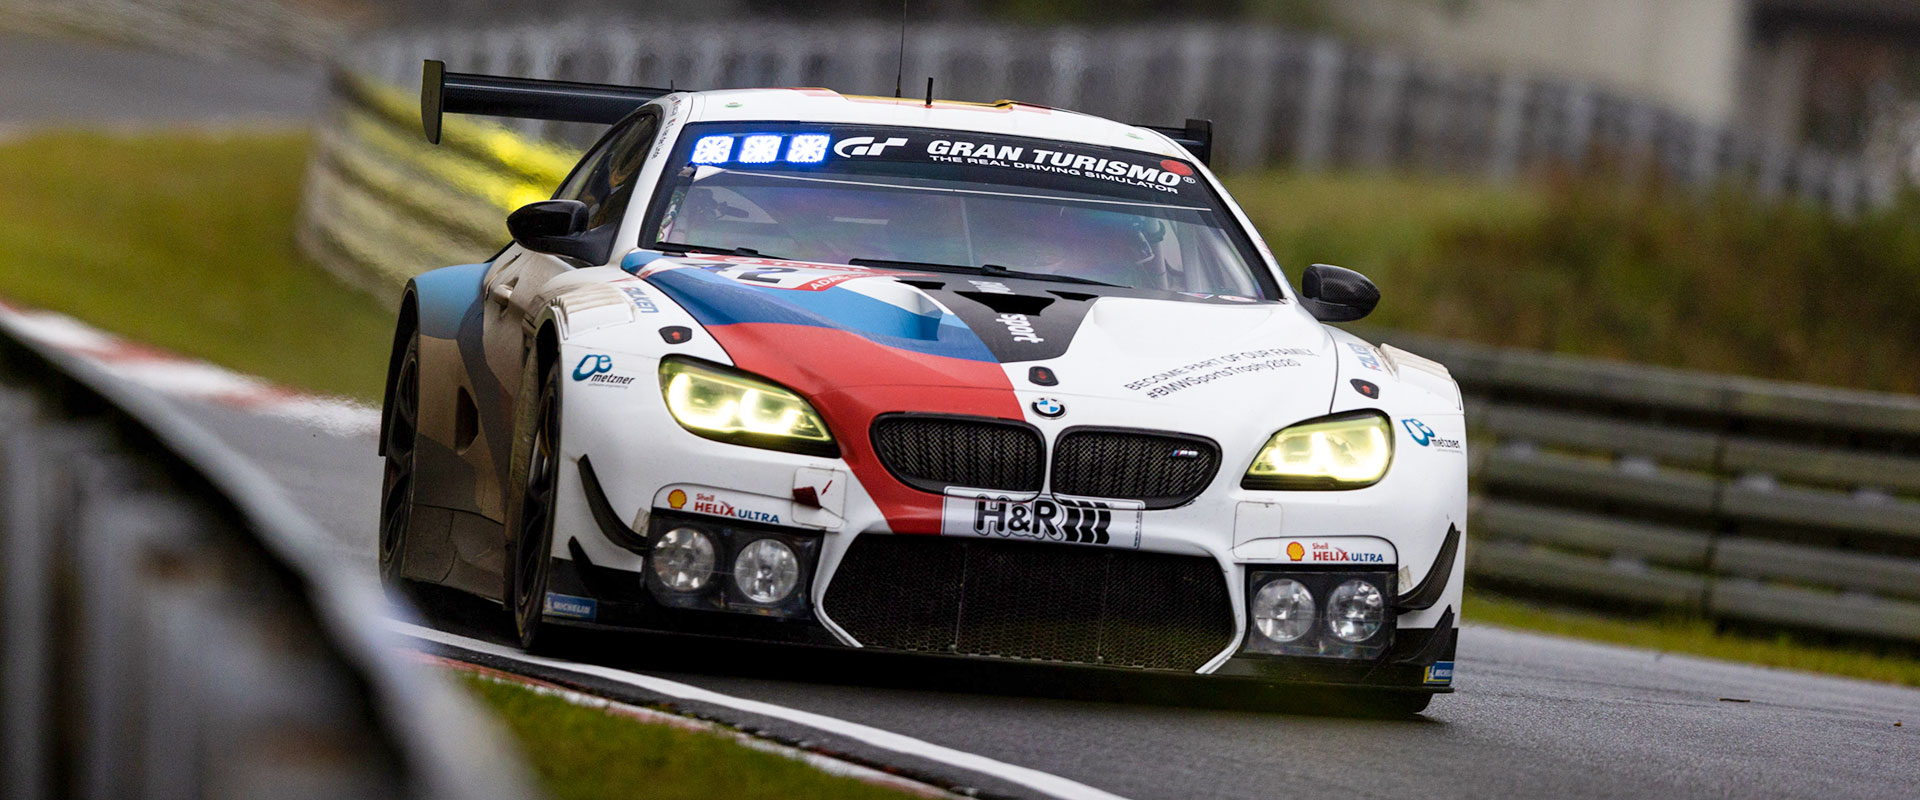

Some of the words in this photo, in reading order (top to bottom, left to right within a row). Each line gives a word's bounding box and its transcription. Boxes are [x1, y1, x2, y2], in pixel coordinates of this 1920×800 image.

[927, 139, 1023, 161] GRAN
[929, 155, 963, 163] THE
[967, 156, 1010, 168] REAL
[1014, 161, 1081, 176] DRIVING
[1084, 171, 1179, 195] SIMULATOR
[995, 313, 1044, 344] sport
[590, 373, 636, 385] metzner
[1124, 366, 1190, 392] BECOME
[1185, 358, 1223, 371] PART
[1220, 353, 1243, 363] OF
[1240, 349, 1273, 359] OUR
[695, 492, 715, 502] Shell
[694, 500, 736, 517] HELIX
[738, 508, 780, 524] ULTRA
[974, 495, 1060, 538] H&R
[1312, 542, 1329, 550] Shell
[1312, 549, 1350, 562] HELIX
[1351, 552, 1384, 563] ULTRA
